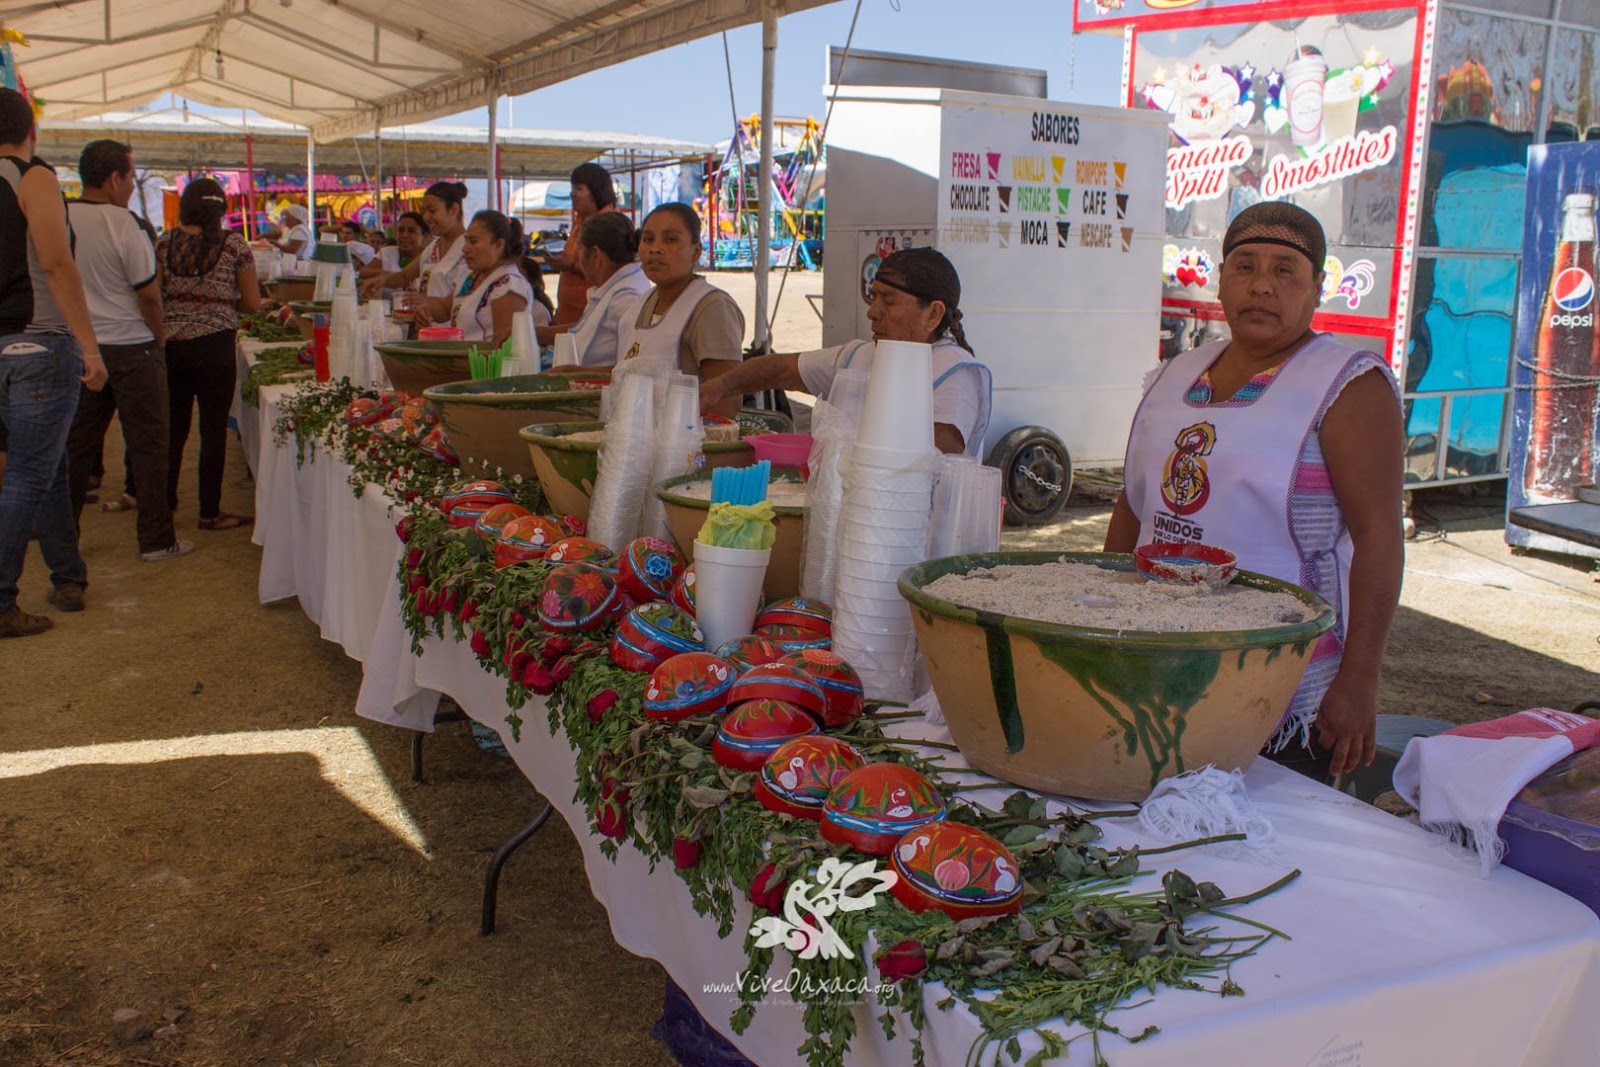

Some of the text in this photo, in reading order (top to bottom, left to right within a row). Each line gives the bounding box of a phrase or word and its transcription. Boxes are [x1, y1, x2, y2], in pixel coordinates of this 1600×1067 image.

[1031, 111, 1080, 146] SABORES
[952, 151, 981, 179] FRESA
[1167, 141, 1246, 171] anana
[1265, 133, 1391, 196] Smosthies
[950, 184, 990, 212] CHOCOLATE
[1017, 186, 1052, 212] PISTACHE
[1165, 168, 1225, 205] Split
[1082, 190, 1107, 215] CAFE
[1020, 220, 1048, 246] MOCA
[1080, 223, 1112, 248] NESCAFE
[1550, 312, 1593, 329] pepsi
[1153, 514, 1204, 541] UNIDOS
